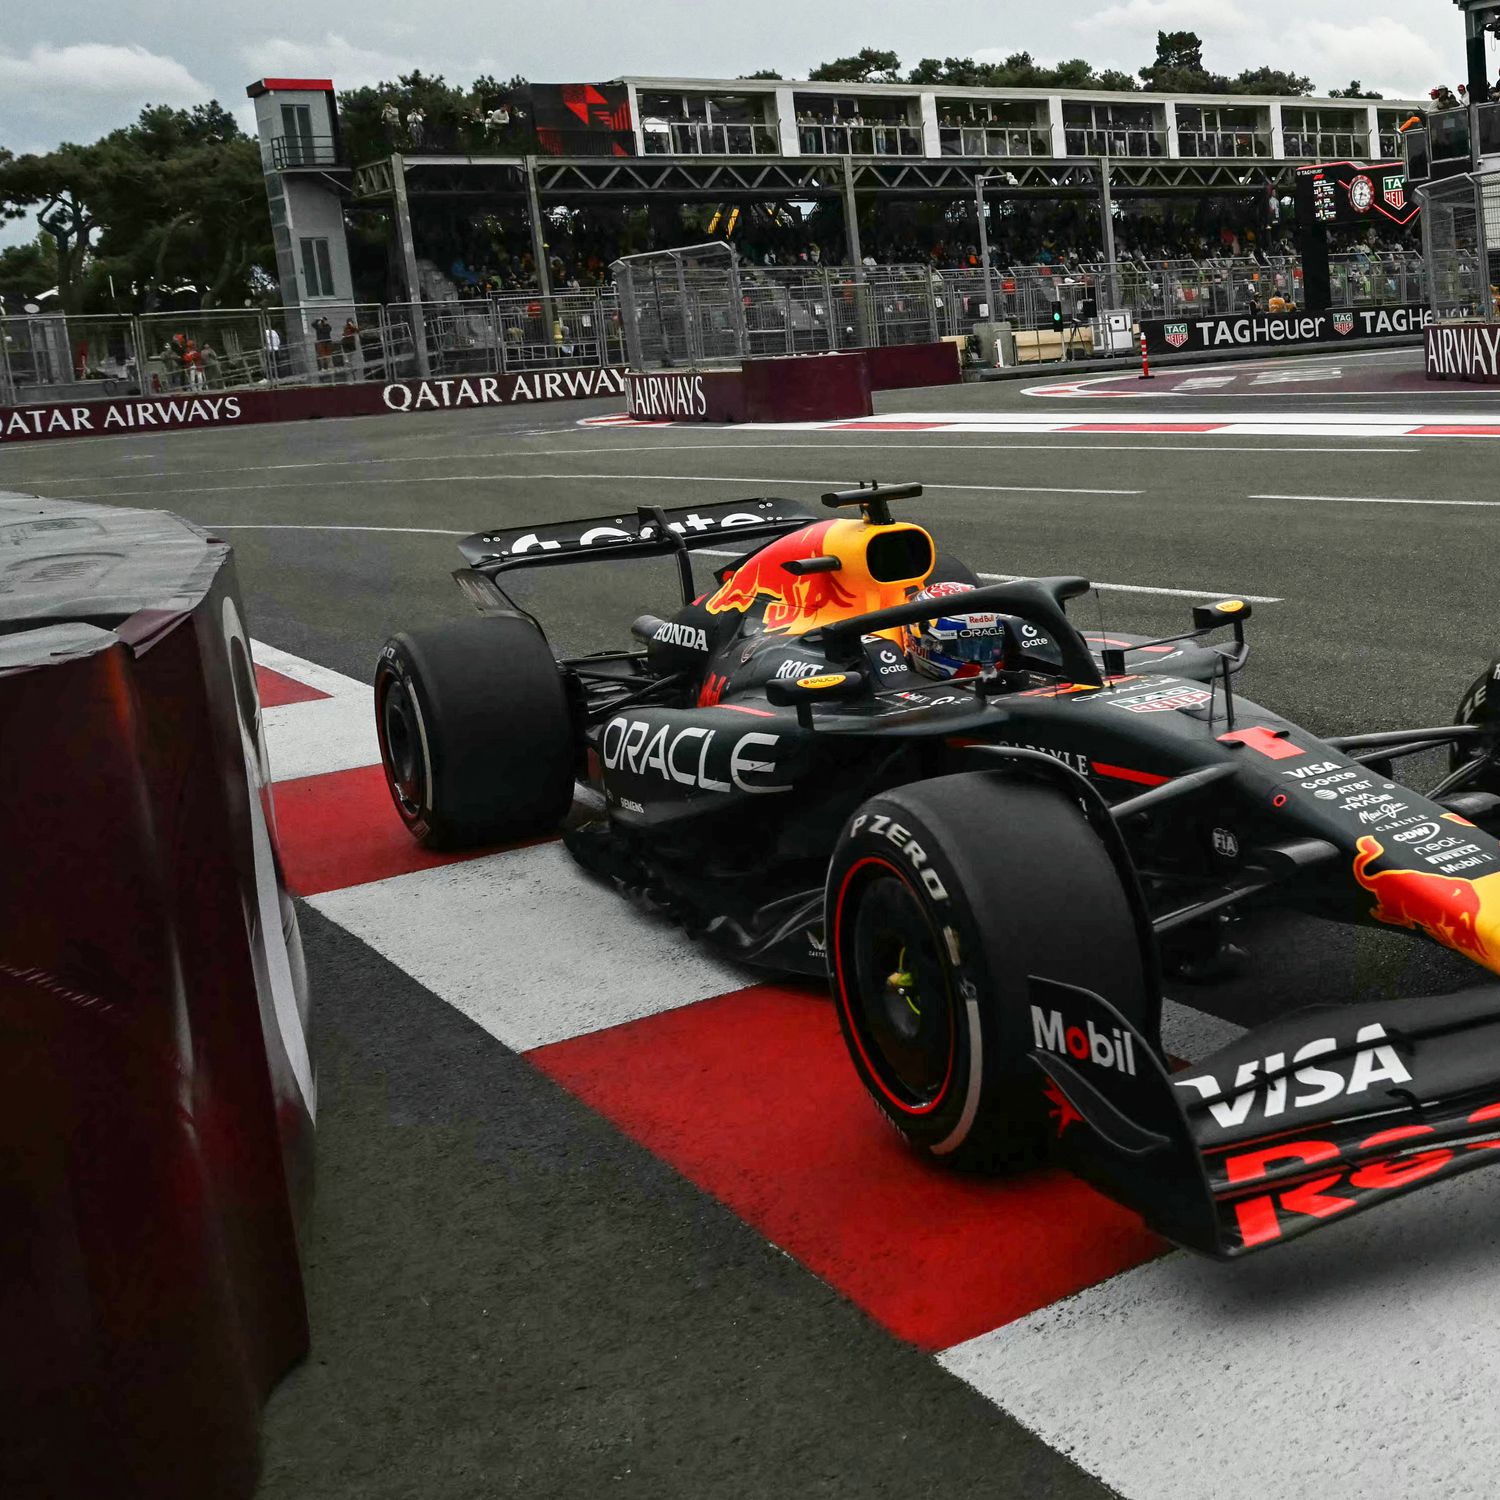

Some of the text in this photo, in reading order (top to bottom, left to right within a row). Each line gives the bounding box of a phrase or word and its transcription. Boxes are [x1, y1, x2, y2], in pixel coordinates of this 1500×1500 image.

[1335, 314, 1352, 322] TAG
[1166, 325, 1186, 334] TAG
[1165, 333, 1189, 345] HEUER
[383, 377, 502, 412] QATAR
[511, 367, 630, 401] AIRWAY
[636, 376, 706, 415] AIRWAYS
[0, 396, 241, 438] ATAR AIRWAYS
[653, 622, 708, 652] HONDA
[1022, 637, 1048, 648] Gate
[776, 660, 824, 679] ROKT
[880, 663, 908, 675] Gate
[603, 717, 793, 793] ORACLE
[1282, 761, 1342, 779] VISA
[1337, 780, 1373, 795] AT&T
[1339, 794, 1394, 810] TRADE
[1345, 793, 1375, 803] AVA
[1375, 814, 1429, 832] CARLYLE
[1213, 832, 1237, 853] FIA
[1393, 826, 1430, 842] CDW
[851, 814, 948, 900] P ZERO
[1425, 844, 1482, 865] PIRELLI
[1440, 856, 1483, 873] Mobil
[1031, 1004, 1136, 1076] Mobil
[1173, 1023, 1413, 1128] VISA
